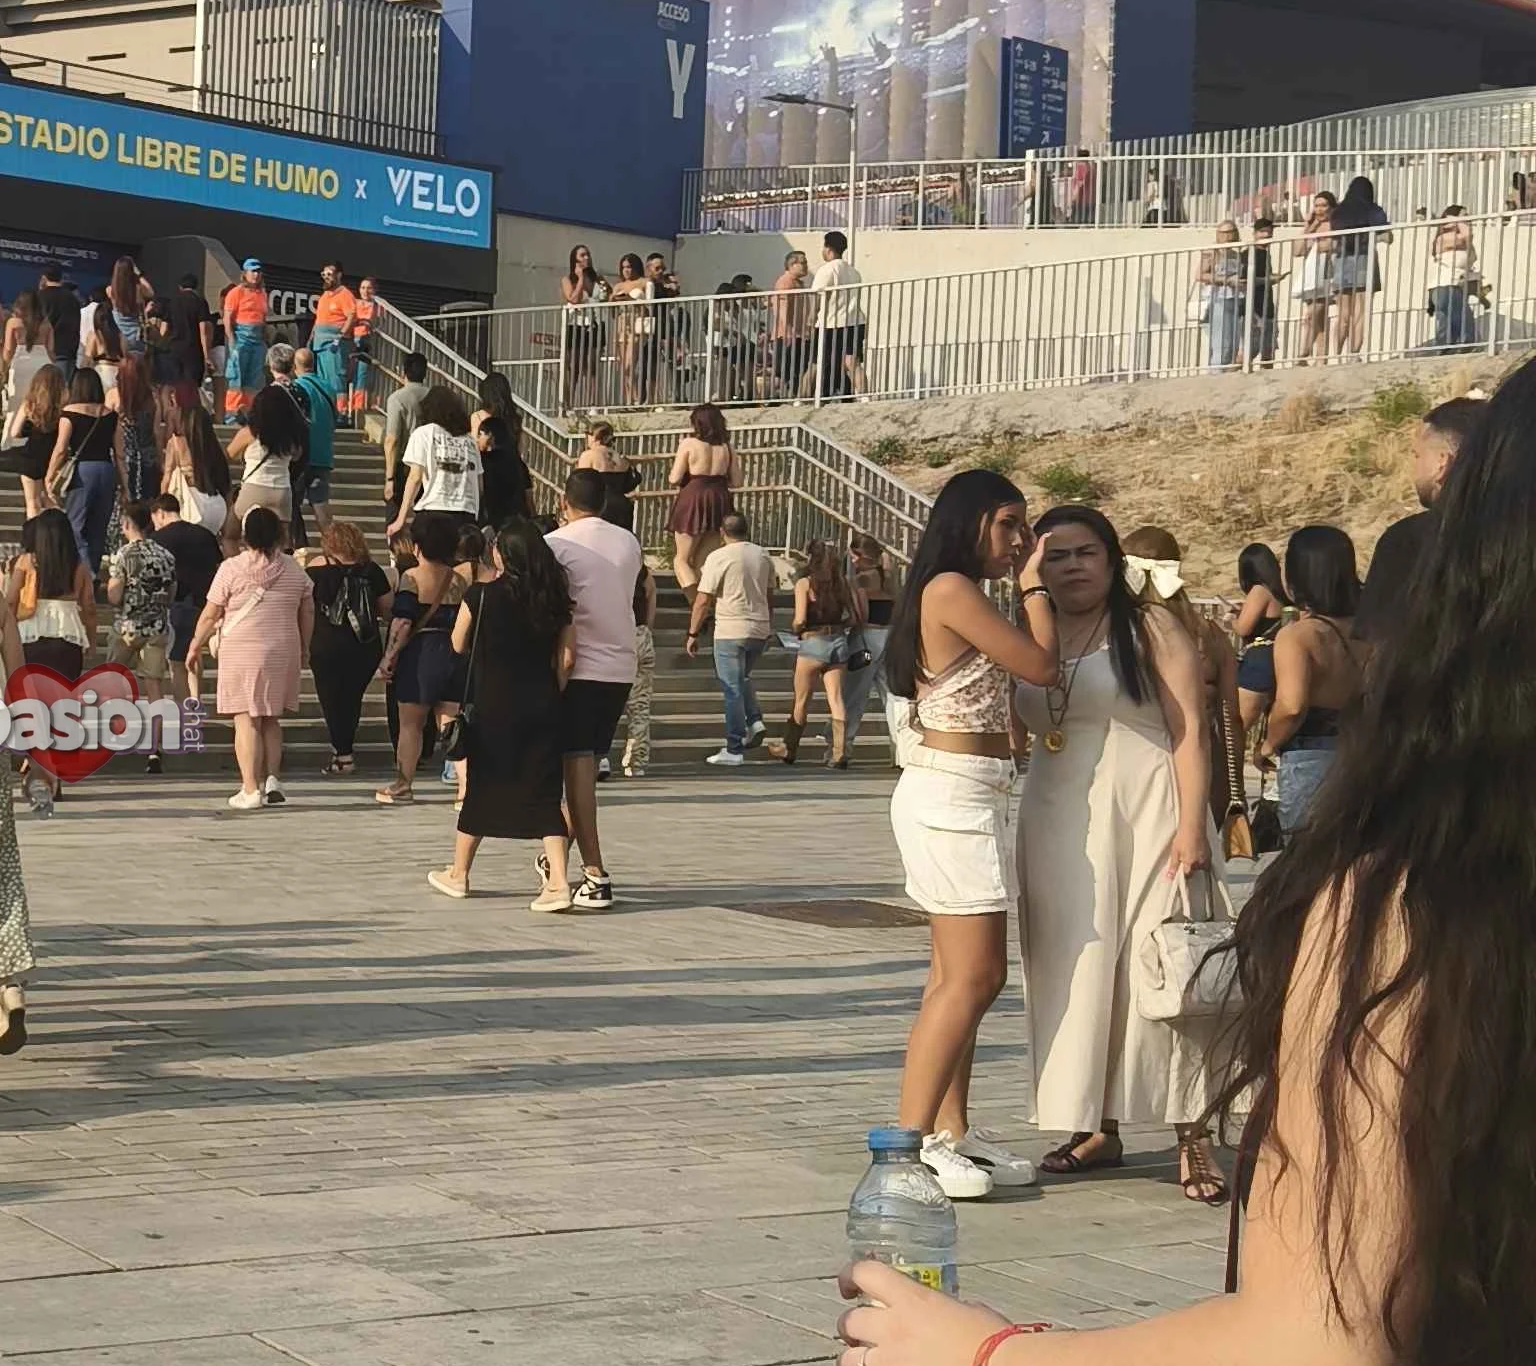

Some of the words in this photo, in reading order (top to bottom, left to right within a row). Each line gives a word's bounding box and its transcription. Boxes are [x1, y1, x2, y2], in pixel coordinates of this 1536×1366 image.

[657, 1, 690, 23] ACCESO
[666, 38, 696, 119] Y
[117, 132, 202, 176] LIBRE
[209, 149, 248, 184] DE
[254, 157, 340, 200] HUMO
[385, 165, 481, 218] VELO
[433, 435, 468, 448] NISSA
